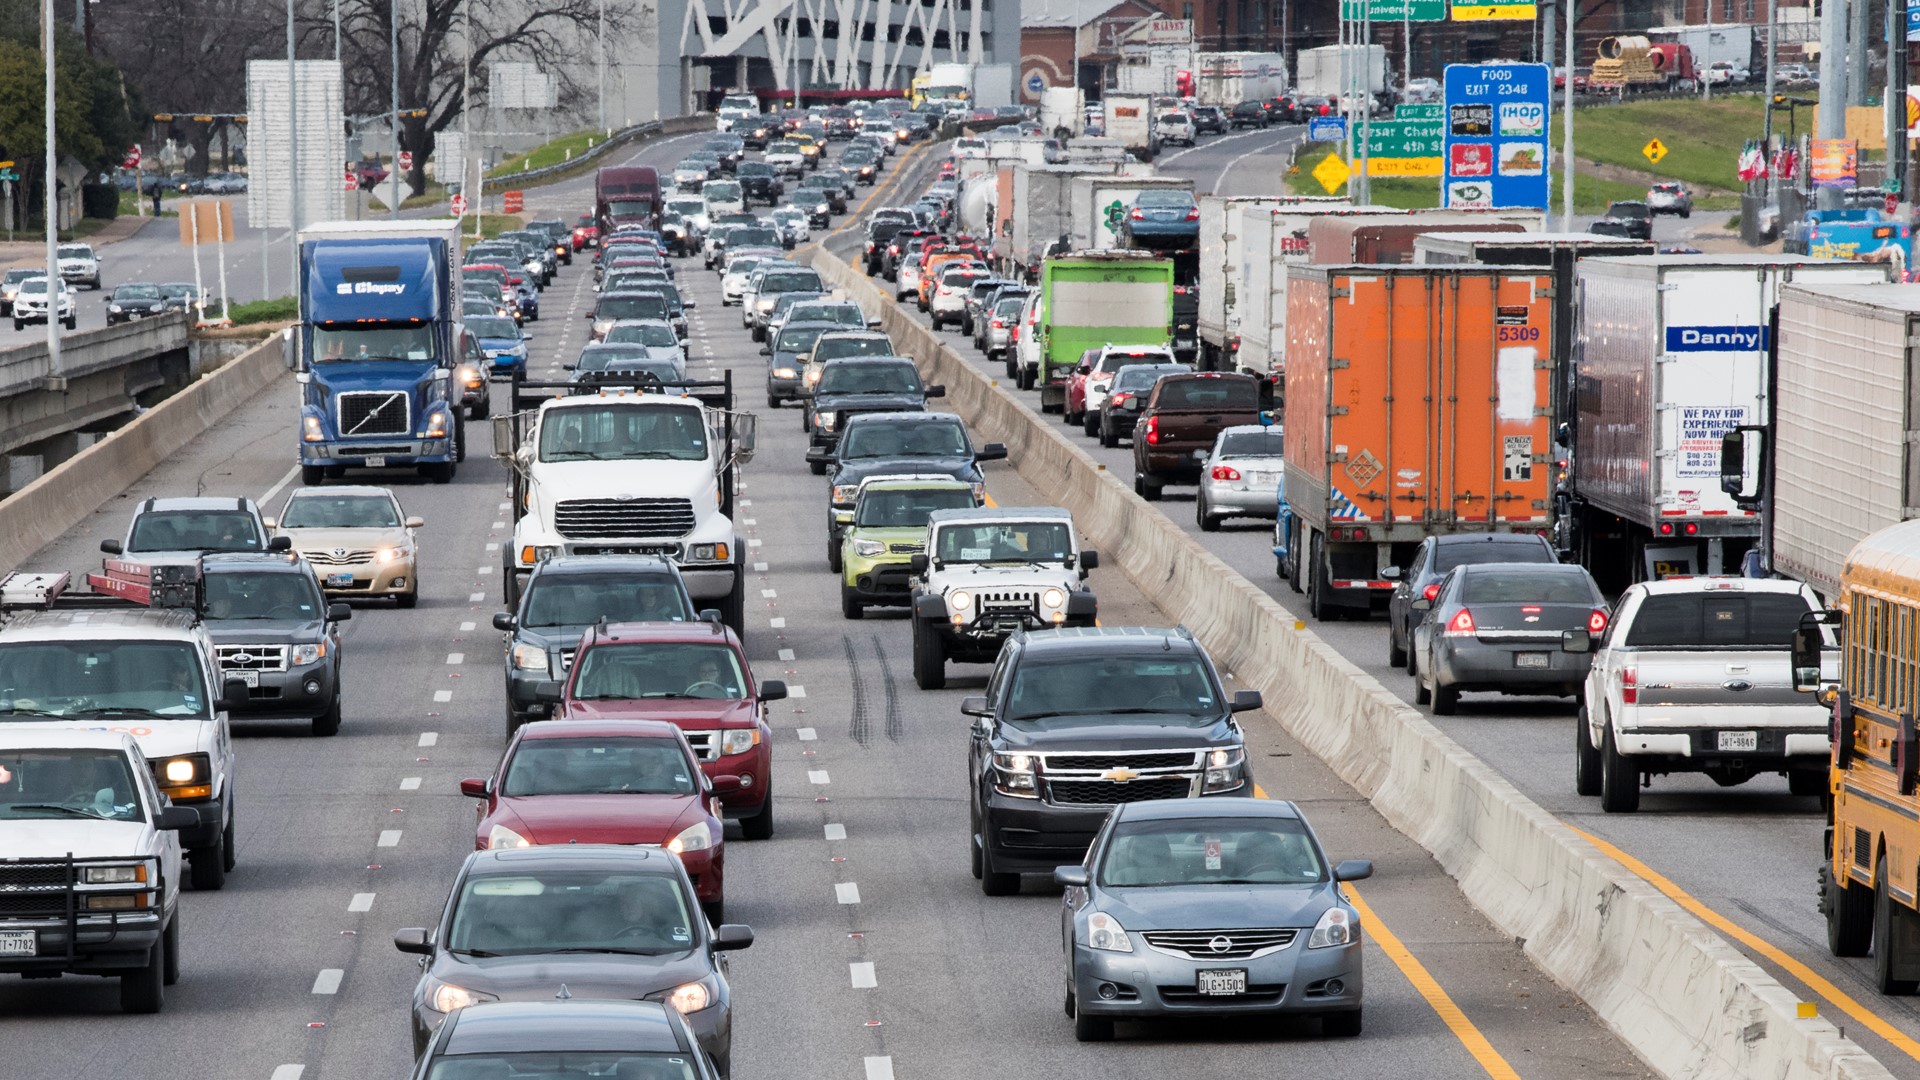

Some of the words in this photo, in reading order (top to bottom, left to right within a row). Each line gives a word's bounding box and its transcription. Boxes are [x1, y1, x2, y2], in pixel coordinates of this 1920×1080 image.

[1481, 70, 1512, 80] FOOD
[1465, 84, 1490, 95] EXIT
[354, 281, 406, 295] Clopay
[1498, 327, 1540, 342] 5309
[1681, 329, 1758, 348] Danny
[1683, 408, 1700, 419] WE
[1702, 408, 1721, 419] PAY
[1725, 408, 1744, 419] FOR
[1684, 430, 1707, 439] NOW
